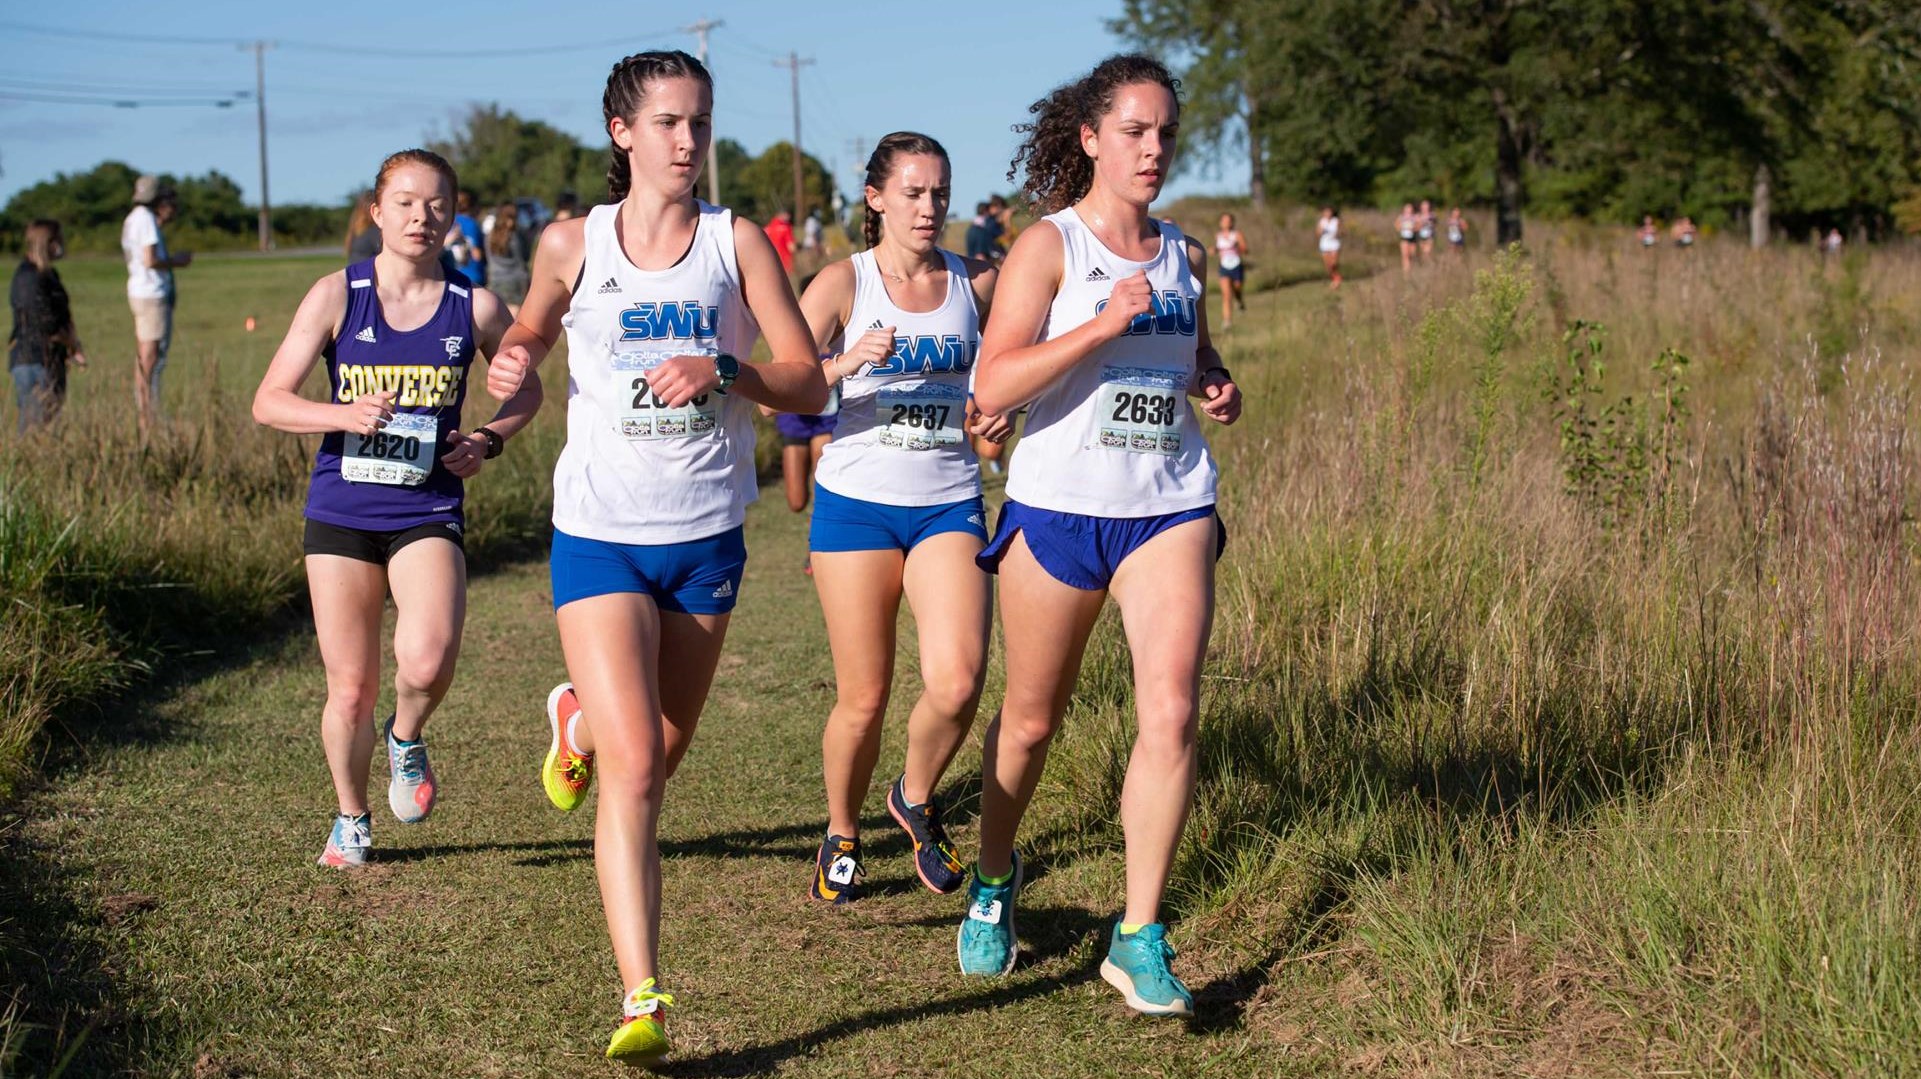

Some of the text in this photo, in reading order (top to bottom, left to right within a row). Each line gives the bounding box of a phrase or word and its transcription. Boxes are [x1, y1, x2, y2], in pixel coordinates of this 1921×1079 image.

[597, 287, 622, 295] adidas
[619, 301, 719, 341] SWU
[1095, 290, 1197, 336] WU
[337, 363, 464, 407] CONVERSE
[891, 403, 951, 431] 2637
[1112, 392, 1176, 426] 2633
[357, 431, 420, 461] 2620
